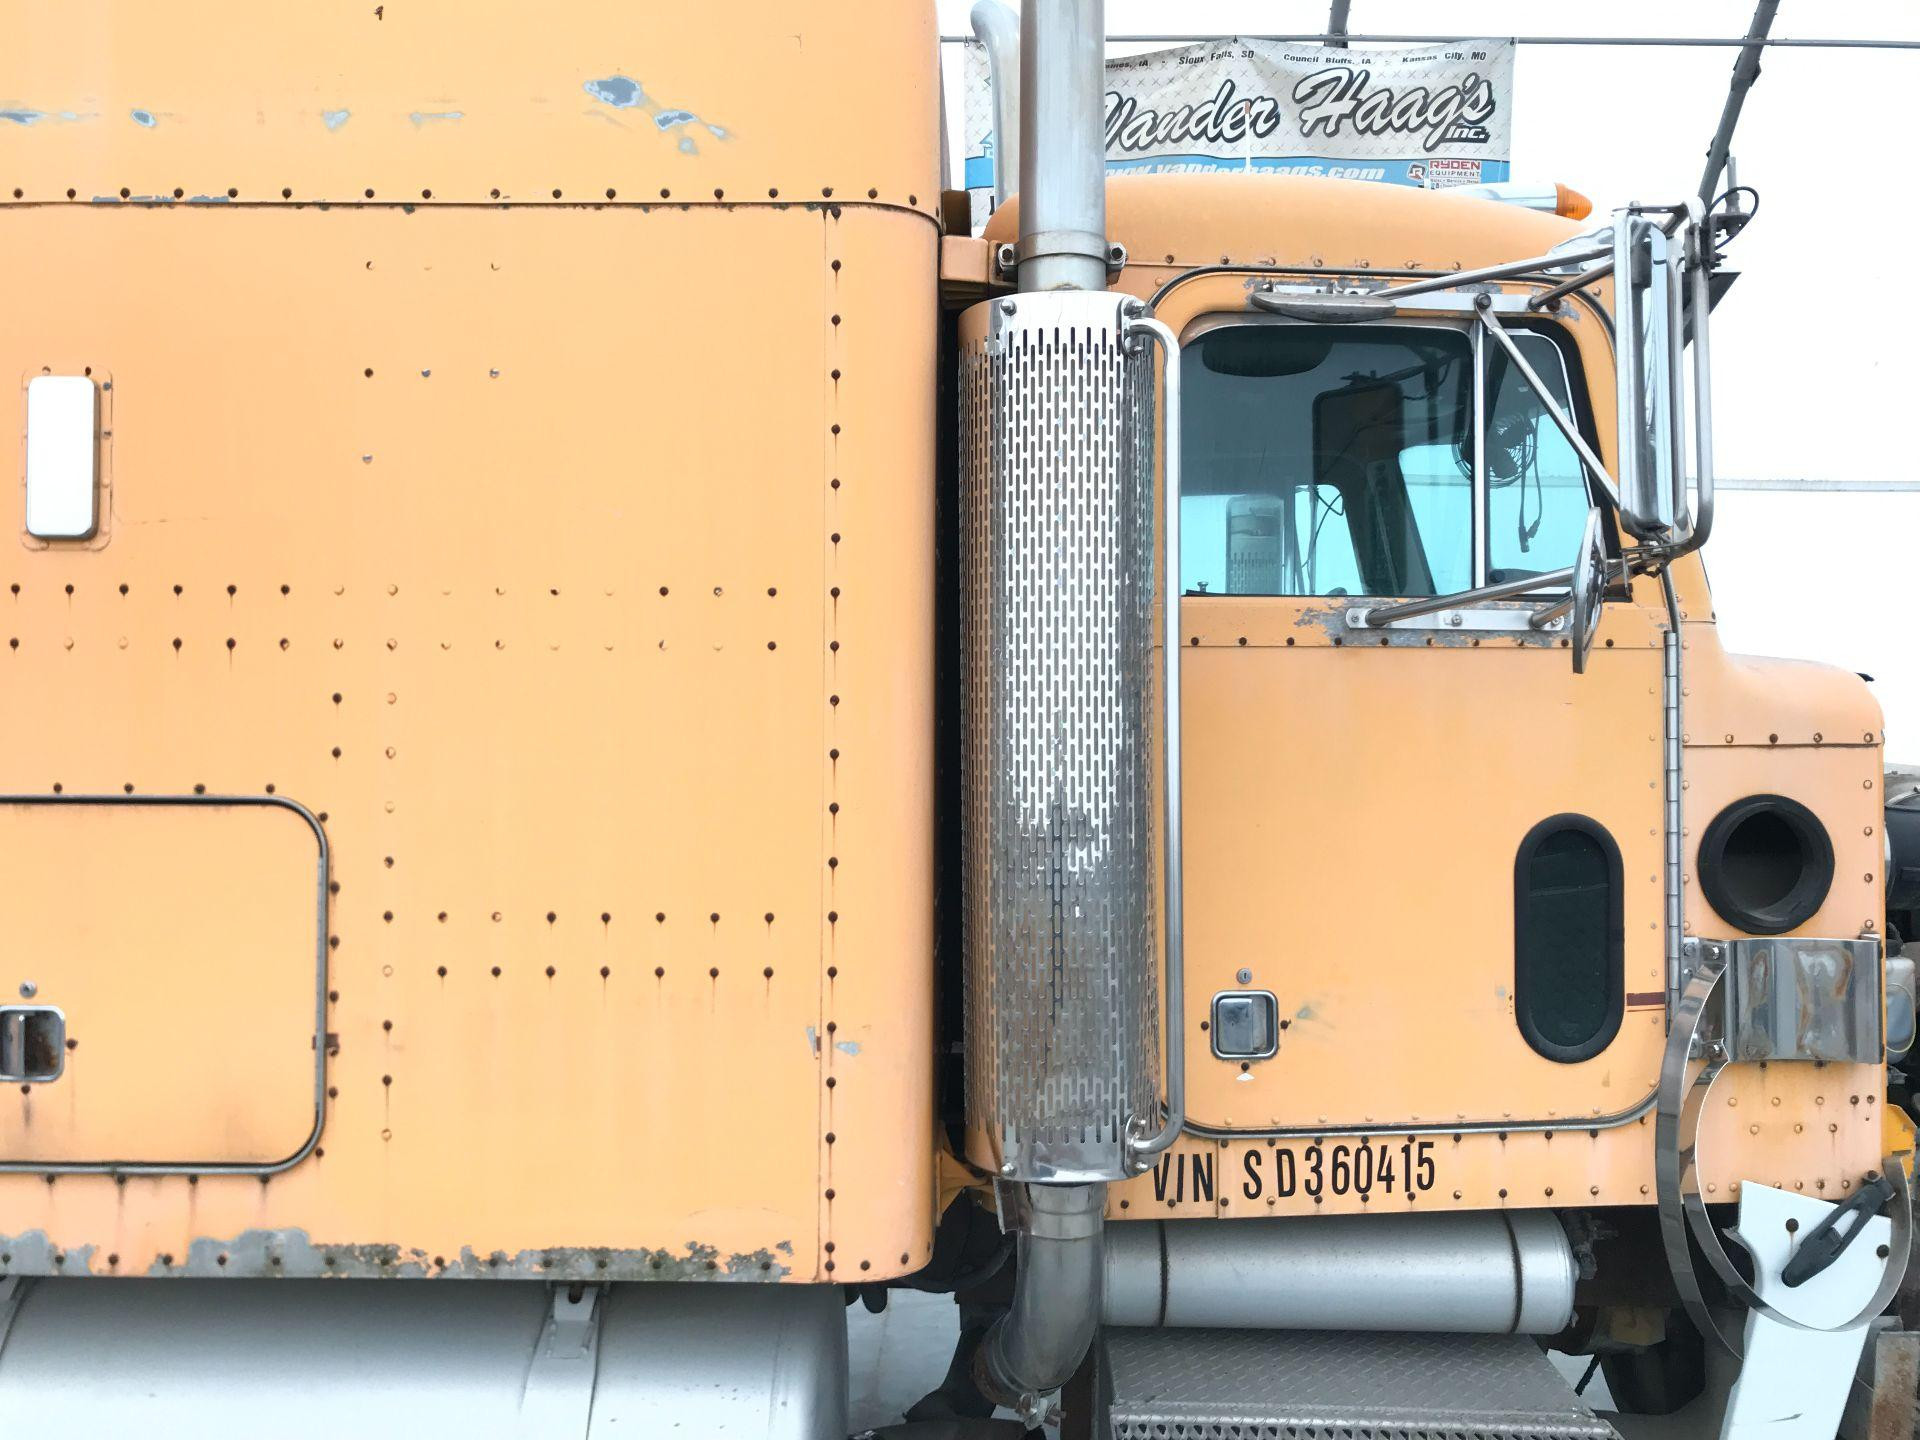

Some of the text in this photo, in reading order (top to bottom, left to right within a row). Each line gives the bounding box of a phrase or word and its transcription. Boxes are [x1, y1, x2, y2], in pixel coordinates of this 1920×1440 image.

[1178, 56, 1204, 65] Sioux
[1241, 50, 1255, 59] SD
[1283, 53, 1319, 63] Council
[1402, 54, 1438, 63] Kansas
[1471, 51, 1487, 61] MO
[1106, 67, 1496, 152] Vander Haag's
[1430, 161, 1480, 170] RYDEN
[1153, 1152, 1213, 1202] VIN
